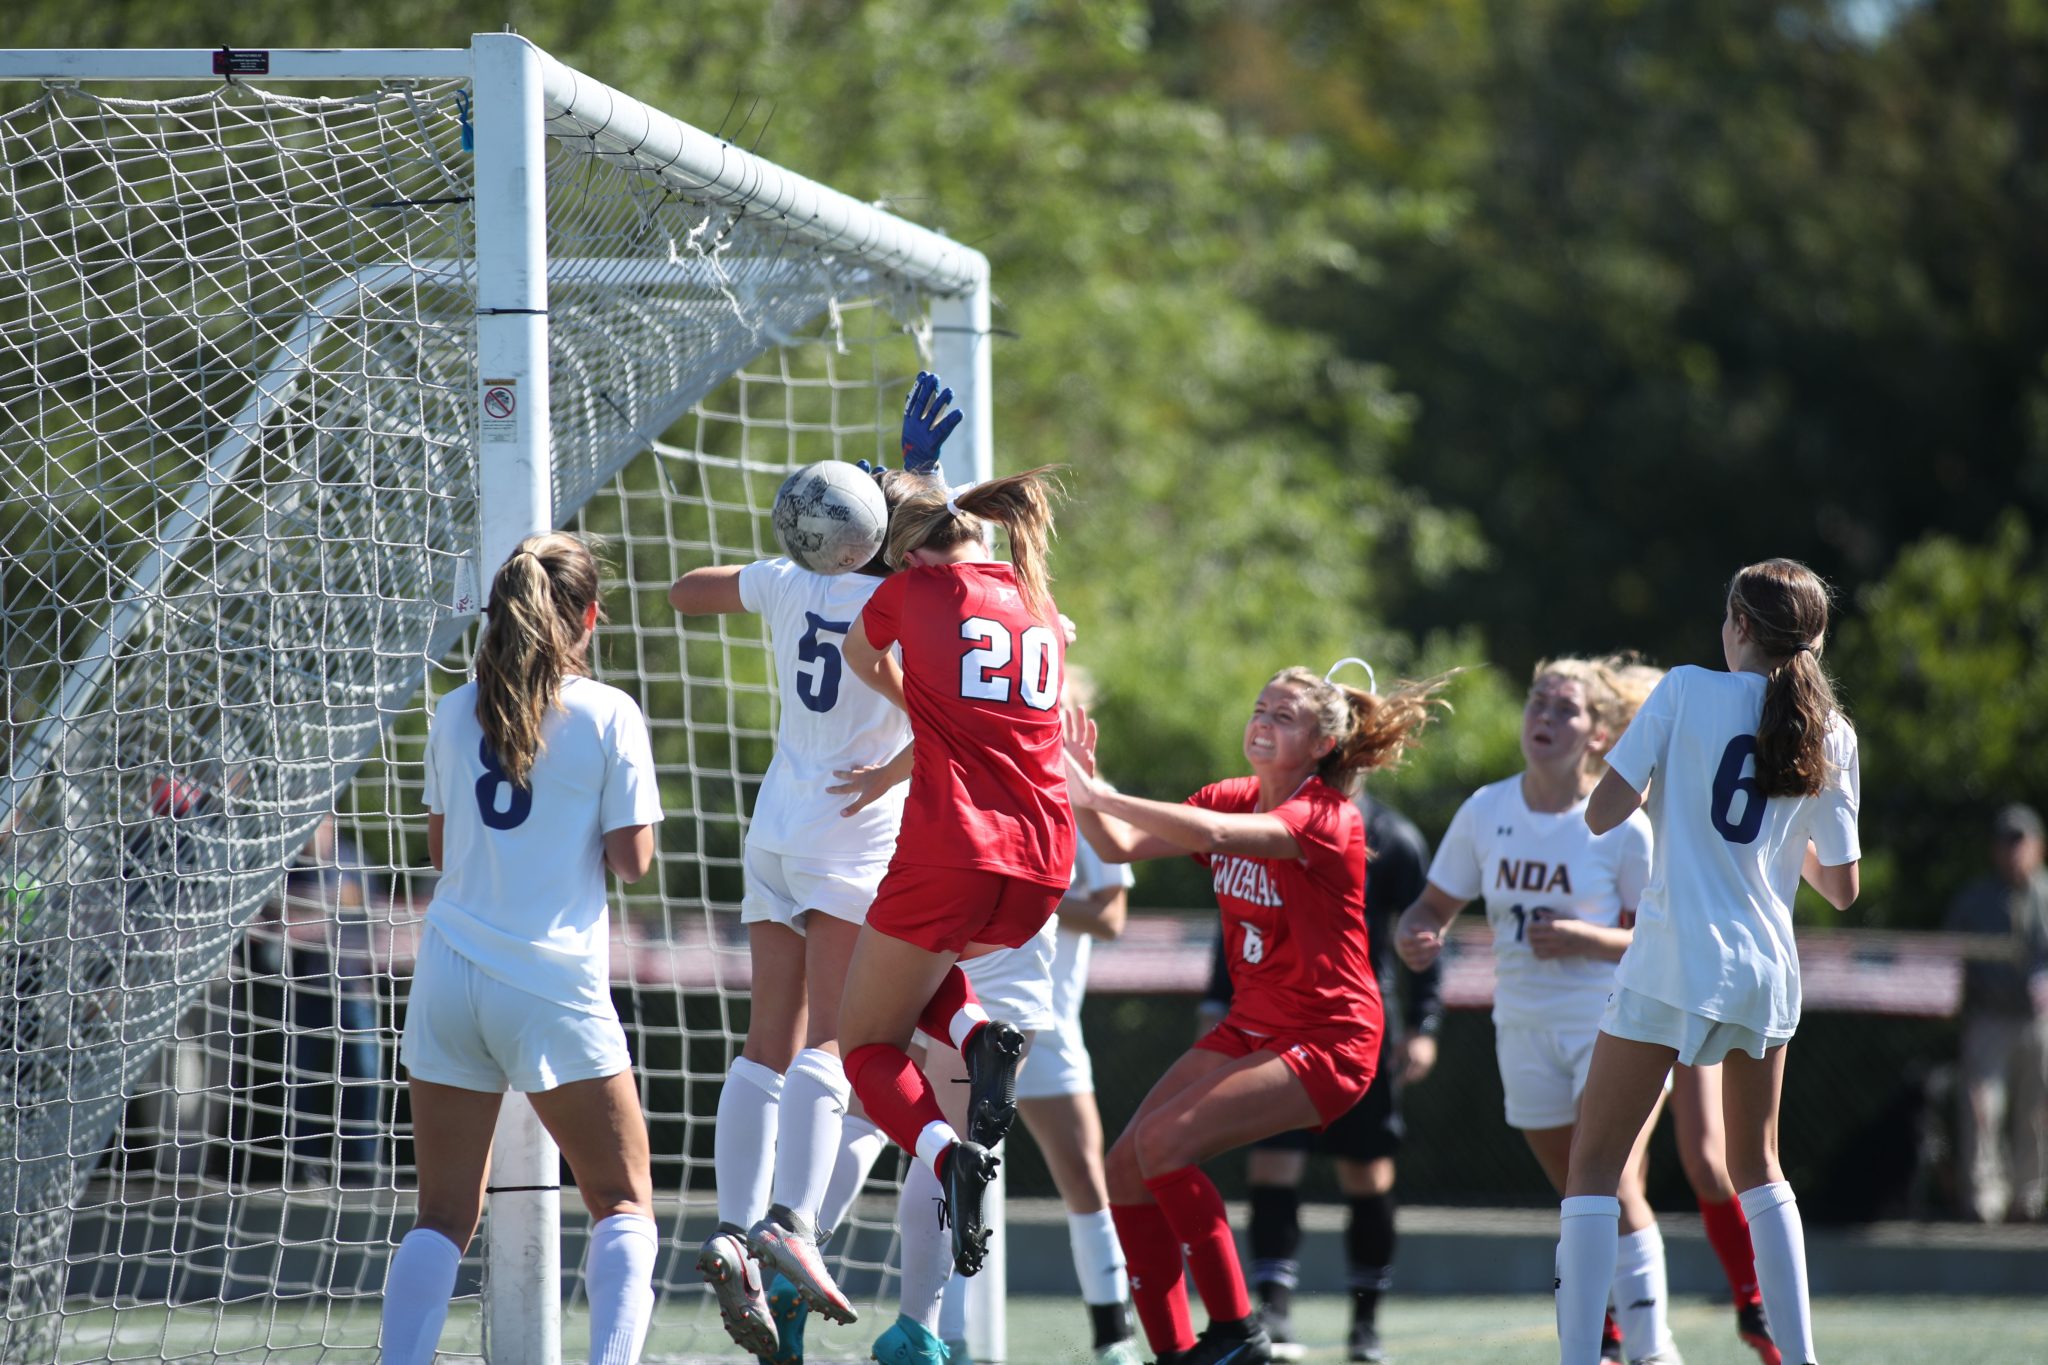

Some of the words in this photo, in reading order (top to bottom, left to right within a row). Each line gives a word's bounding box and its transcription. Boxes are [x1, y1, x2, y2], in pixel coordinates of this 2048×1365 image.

[796, 611, 850, 713] 5
[960, 616, 1058, 711] 20
[475, 734, 535, 830] 8
[1710, 734, 1767, 844] 6
[1496, 858, 1571, 894] NDA
[1510, 904, 1554, 942] 1
